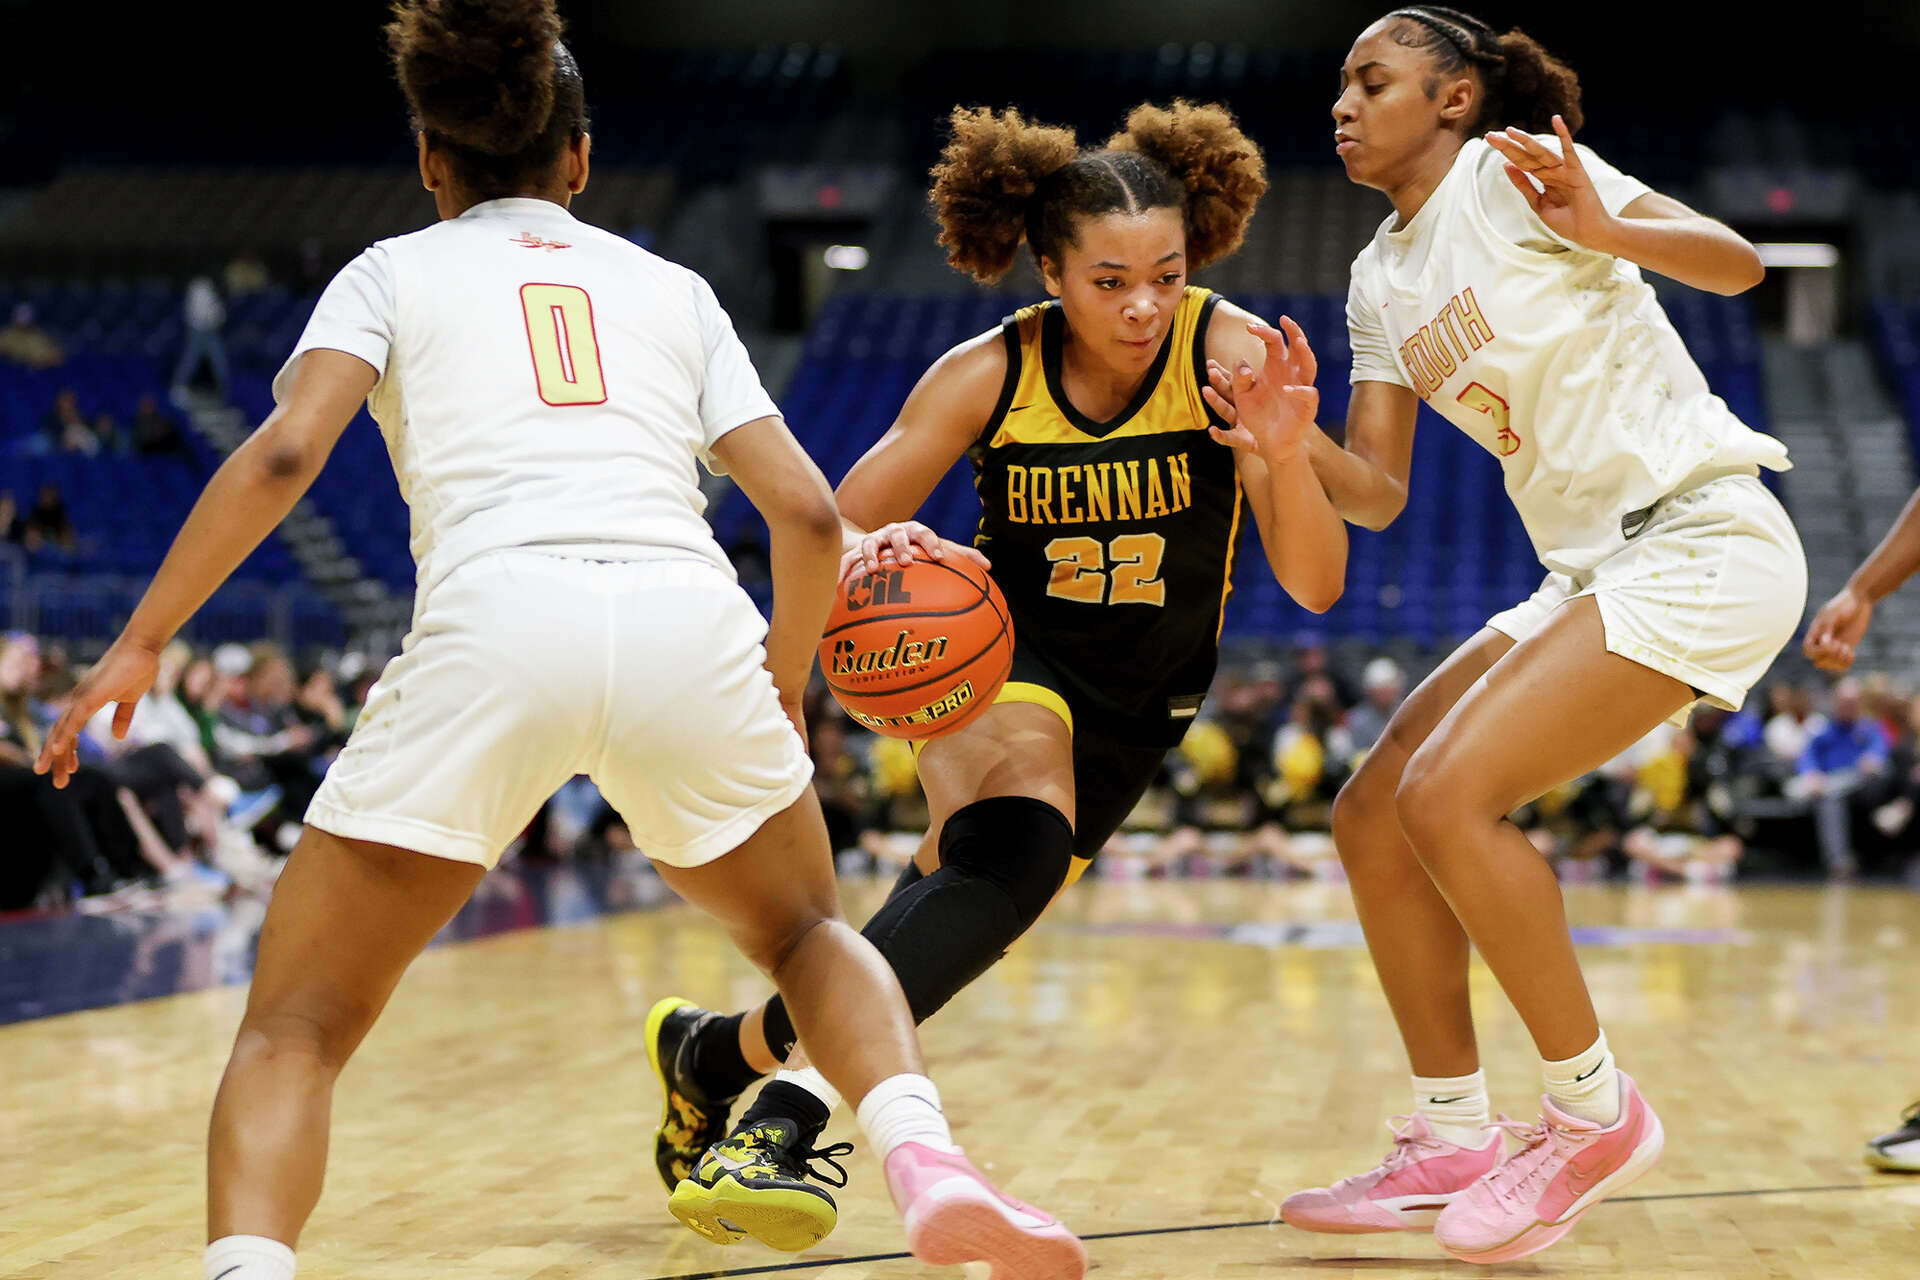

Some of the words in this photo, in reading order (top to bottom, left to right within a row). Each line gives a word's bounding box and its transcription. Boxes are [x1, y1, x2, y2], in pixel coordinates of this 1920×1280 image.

[519, 282, 609, 407] 0
[1007, 452, 1192, 525] BRENNAN
[1044, 533, 1166, 607] 22
[832, 630, 949, 675] Baden
[929, 683, 972, 719] PRO
